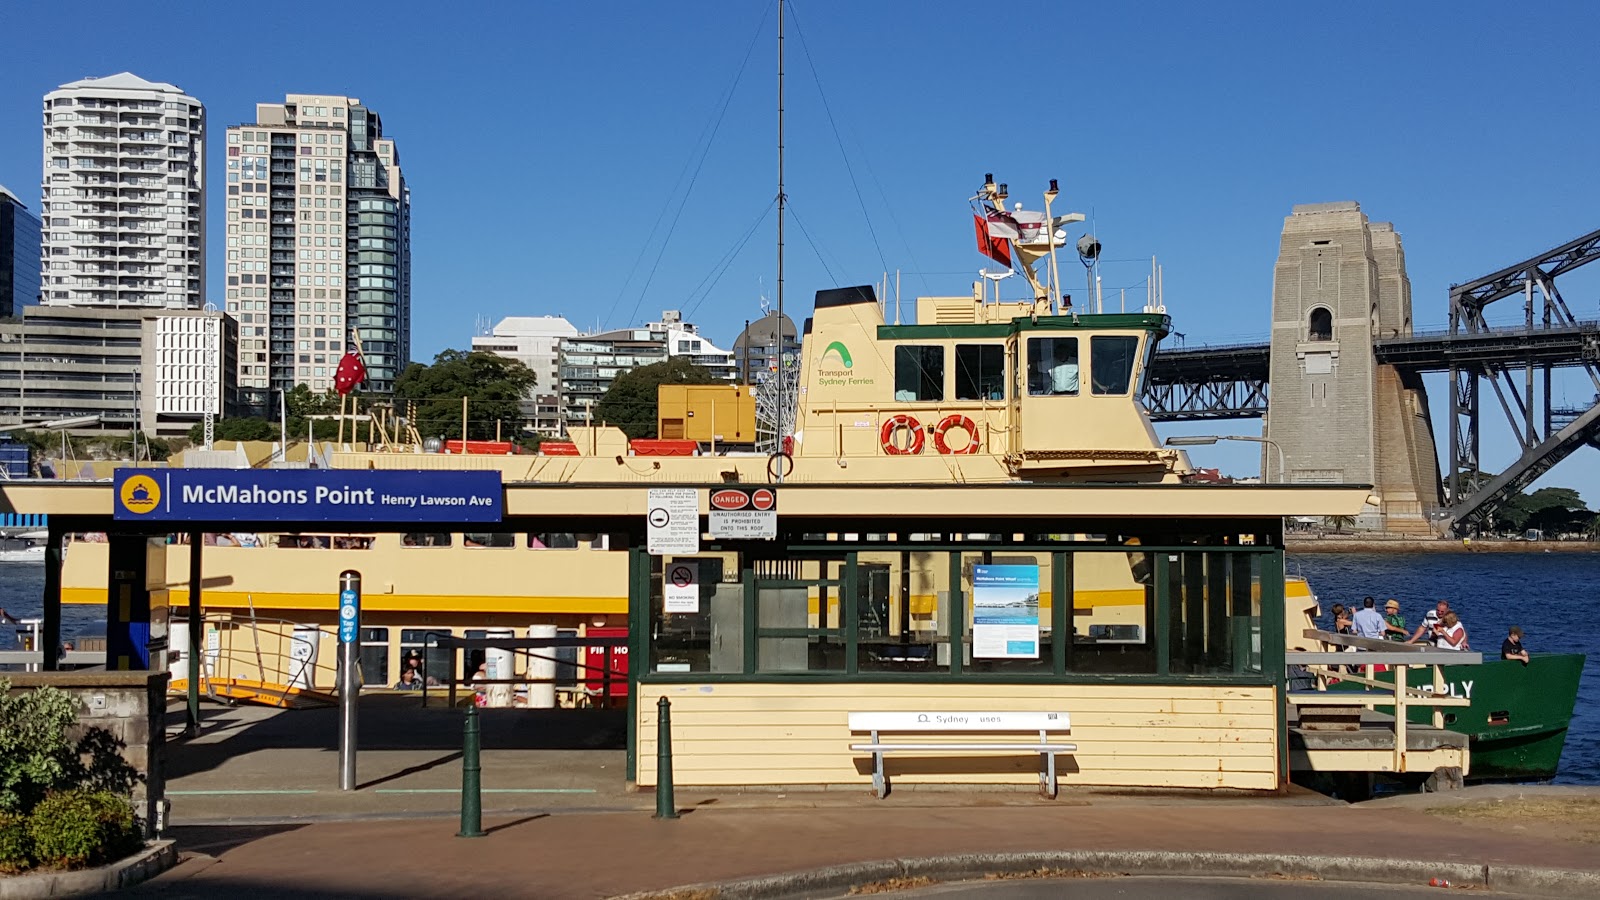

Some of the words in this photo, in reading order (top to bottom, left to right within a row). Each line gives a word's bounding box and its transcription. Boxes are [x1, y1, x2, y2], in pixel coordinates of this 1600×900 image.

[818, 369, 853, 378] Transport
[819, 378, 846, 386] Sydney
[182, 484, 308, 504] McMahons
[315, 486, 375, 504] Point
[381, 494, 417, 507] Henry
[420, 494, 466, 506] Lawson
[469, 495, 493, 506] Ave
[590, 646, 604, 654] FIR
[614, 646, 628, 654] HO
[936, 715, 969, 724] Sydney
